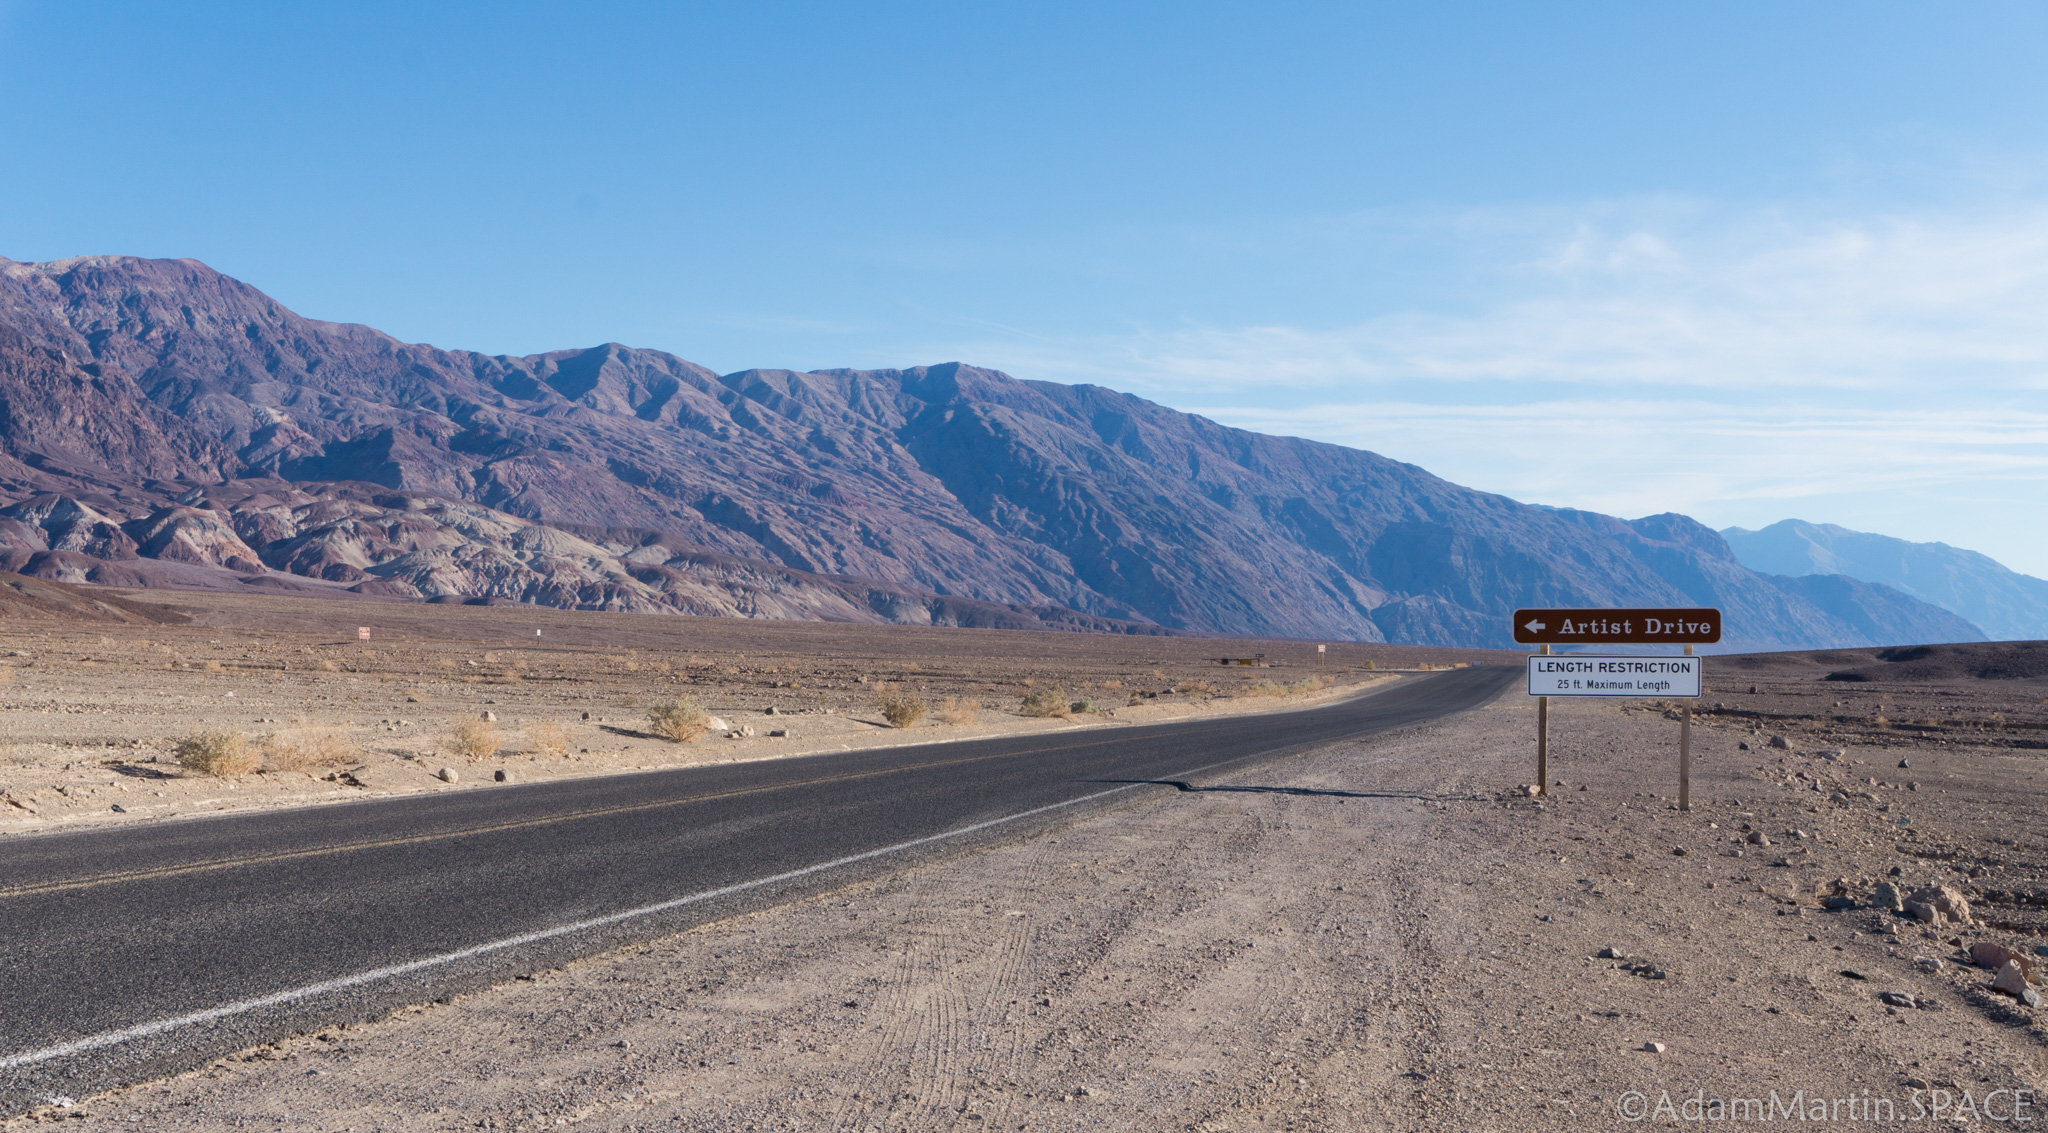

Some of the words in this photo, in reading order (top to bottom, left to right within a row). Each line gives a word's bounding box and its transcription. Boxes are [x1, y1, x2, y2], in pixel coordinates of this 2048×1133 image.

[1558, 618, 1632, 634] Artist
[1645, 618, 1711, 634] Drive
[1538, 662, 1593, 673] LENGTH
[1599, 662, 1691, 673] RESTRICTION
[1557, 680, 1569, 689] 25
[1573, 680, 1583, 689] ft.
[1587, 680, 1633, 689] Maximum
[1637, 680, 1670, 692] Length
